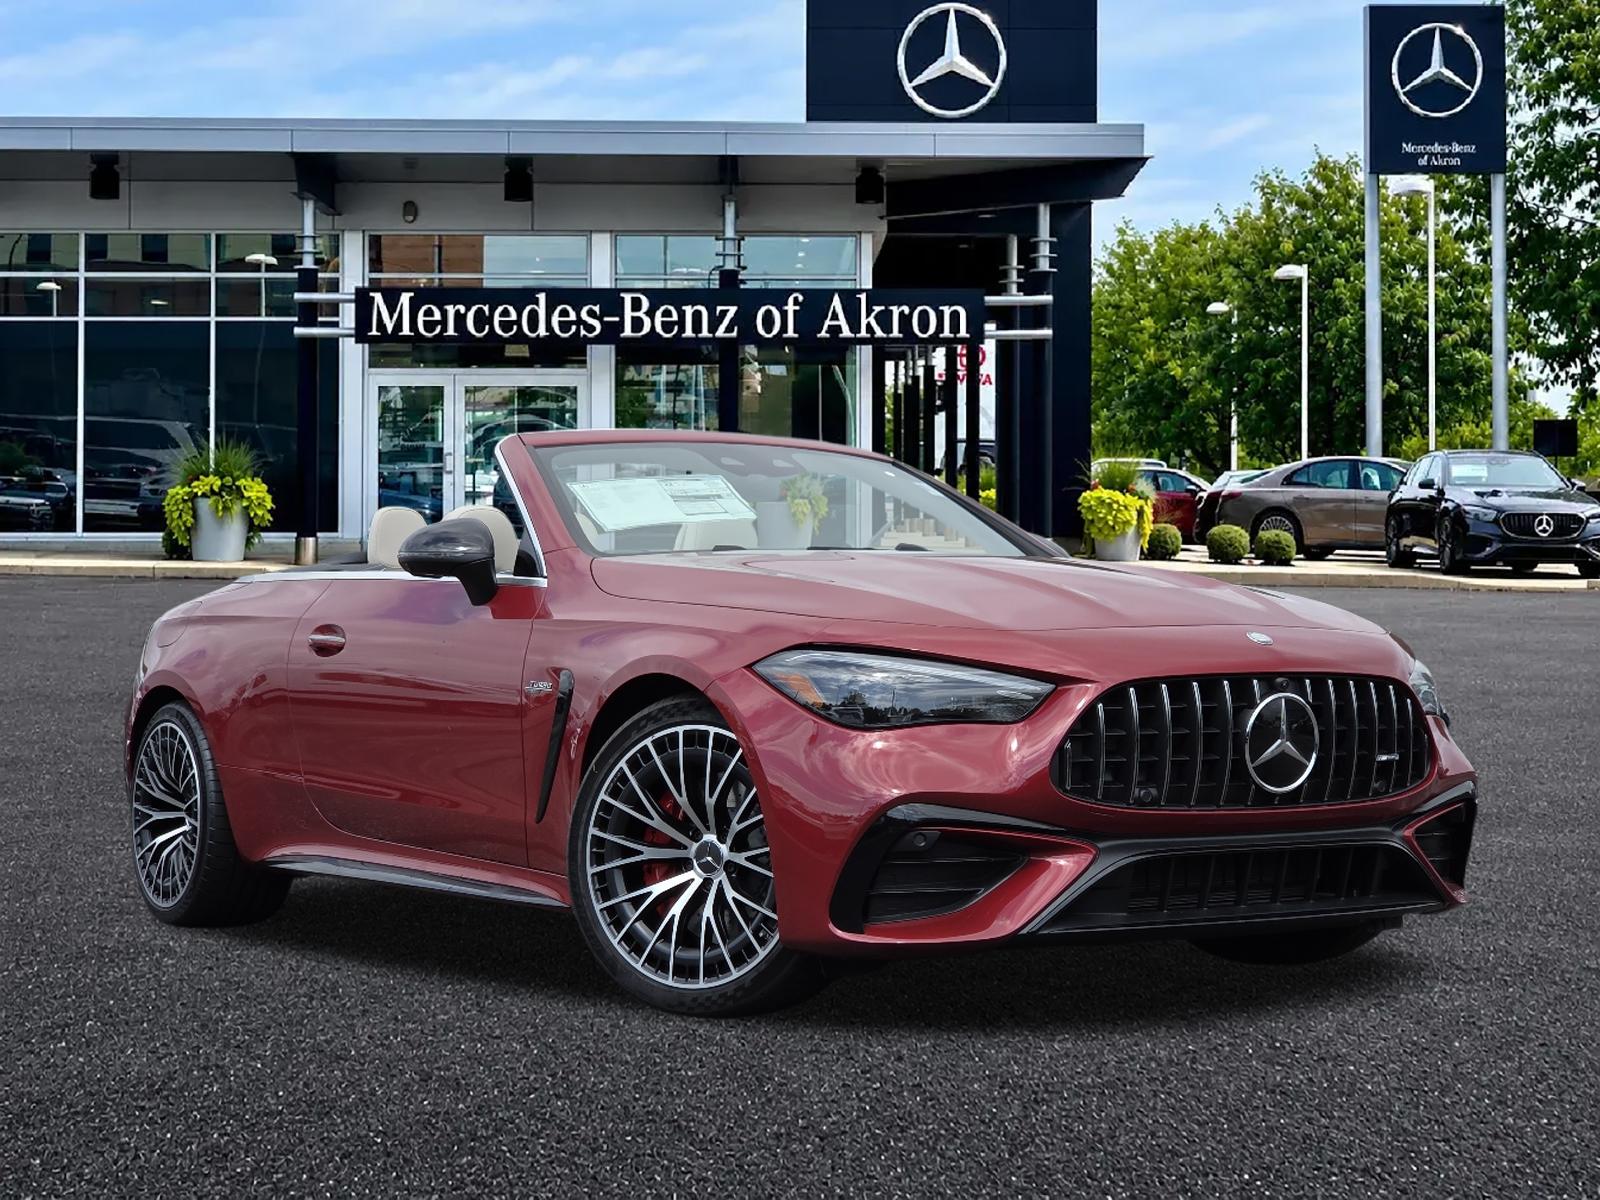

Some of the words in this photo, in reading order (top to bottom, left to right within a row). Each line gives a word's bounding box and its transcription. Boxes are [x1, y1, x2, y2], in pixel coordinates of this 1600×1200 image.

[1401, 141, 1476, 154] Mercedes-Benz
[1417, 154, 1428, 166] of
[1430, 154, 1461, 166] Akron
[367, 291, 738, 338] Mercedes-Benz
[756, 292, 804, 338] of
[816, 292, 970, 338] Akron
